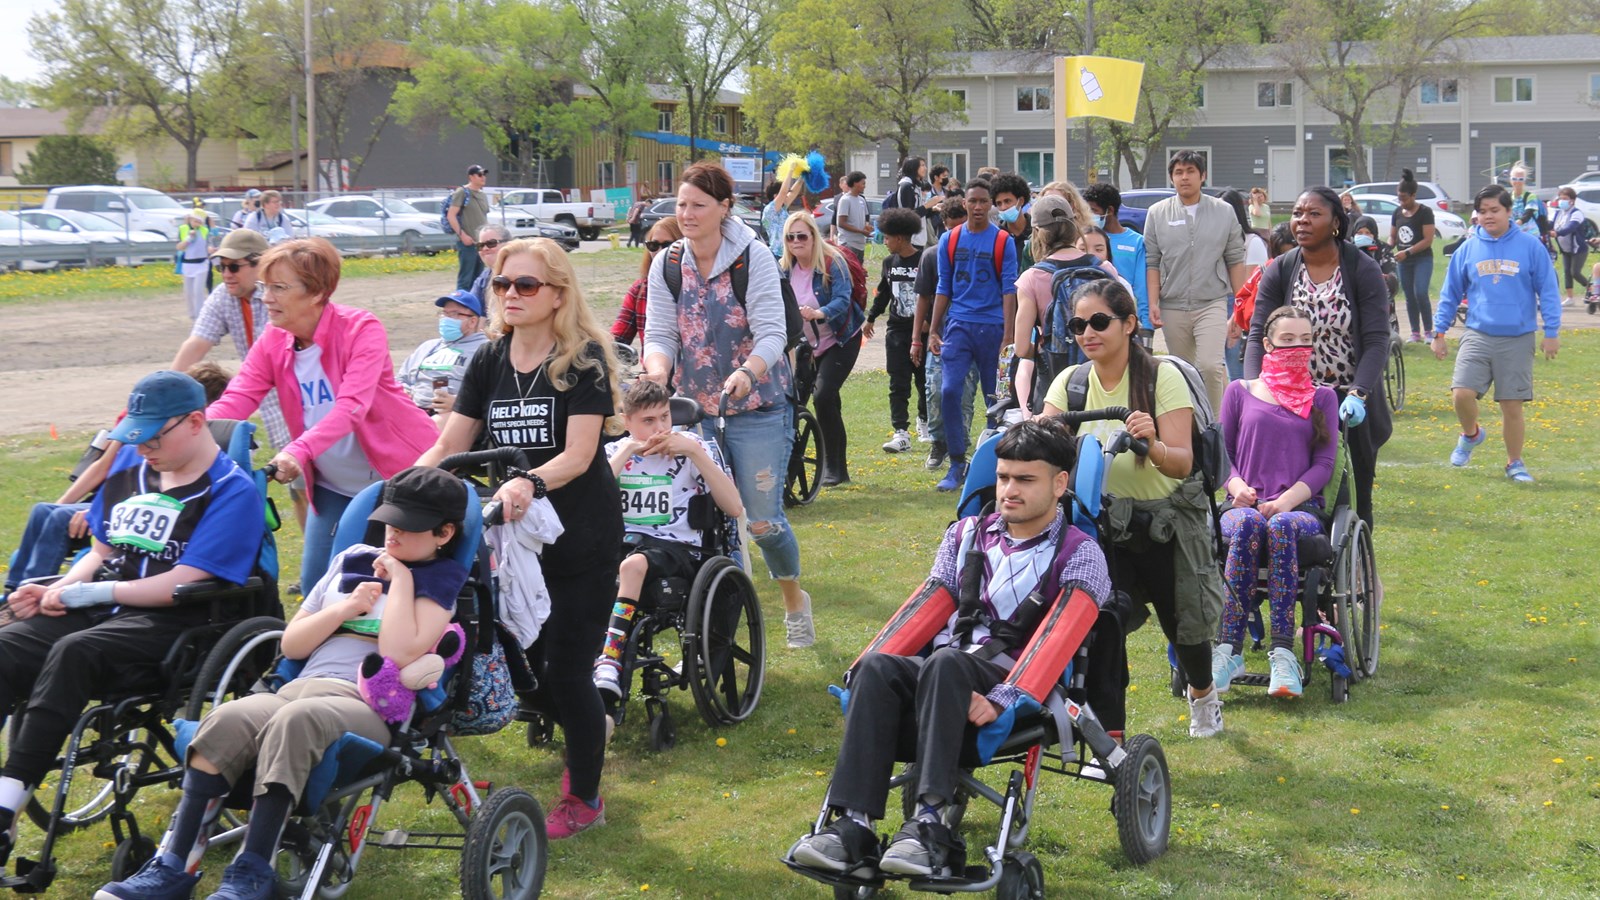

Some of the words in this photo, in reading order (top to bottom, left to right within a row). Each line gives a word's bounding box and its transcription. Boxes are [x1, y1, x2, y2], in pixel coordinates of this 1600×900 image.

[718, 143, 742, 153] S-65
[301, 379, 333, 406] YA
[491, 406, 520, 419] HELP
[521, 404, 549, 417] KIDS
[507, 420, 527, 428] SPECIAL
[492, 428, 549, 444] THRIVE
[620, 490, 669, 514] 3446
[112, 506, 170, 541] 3439
